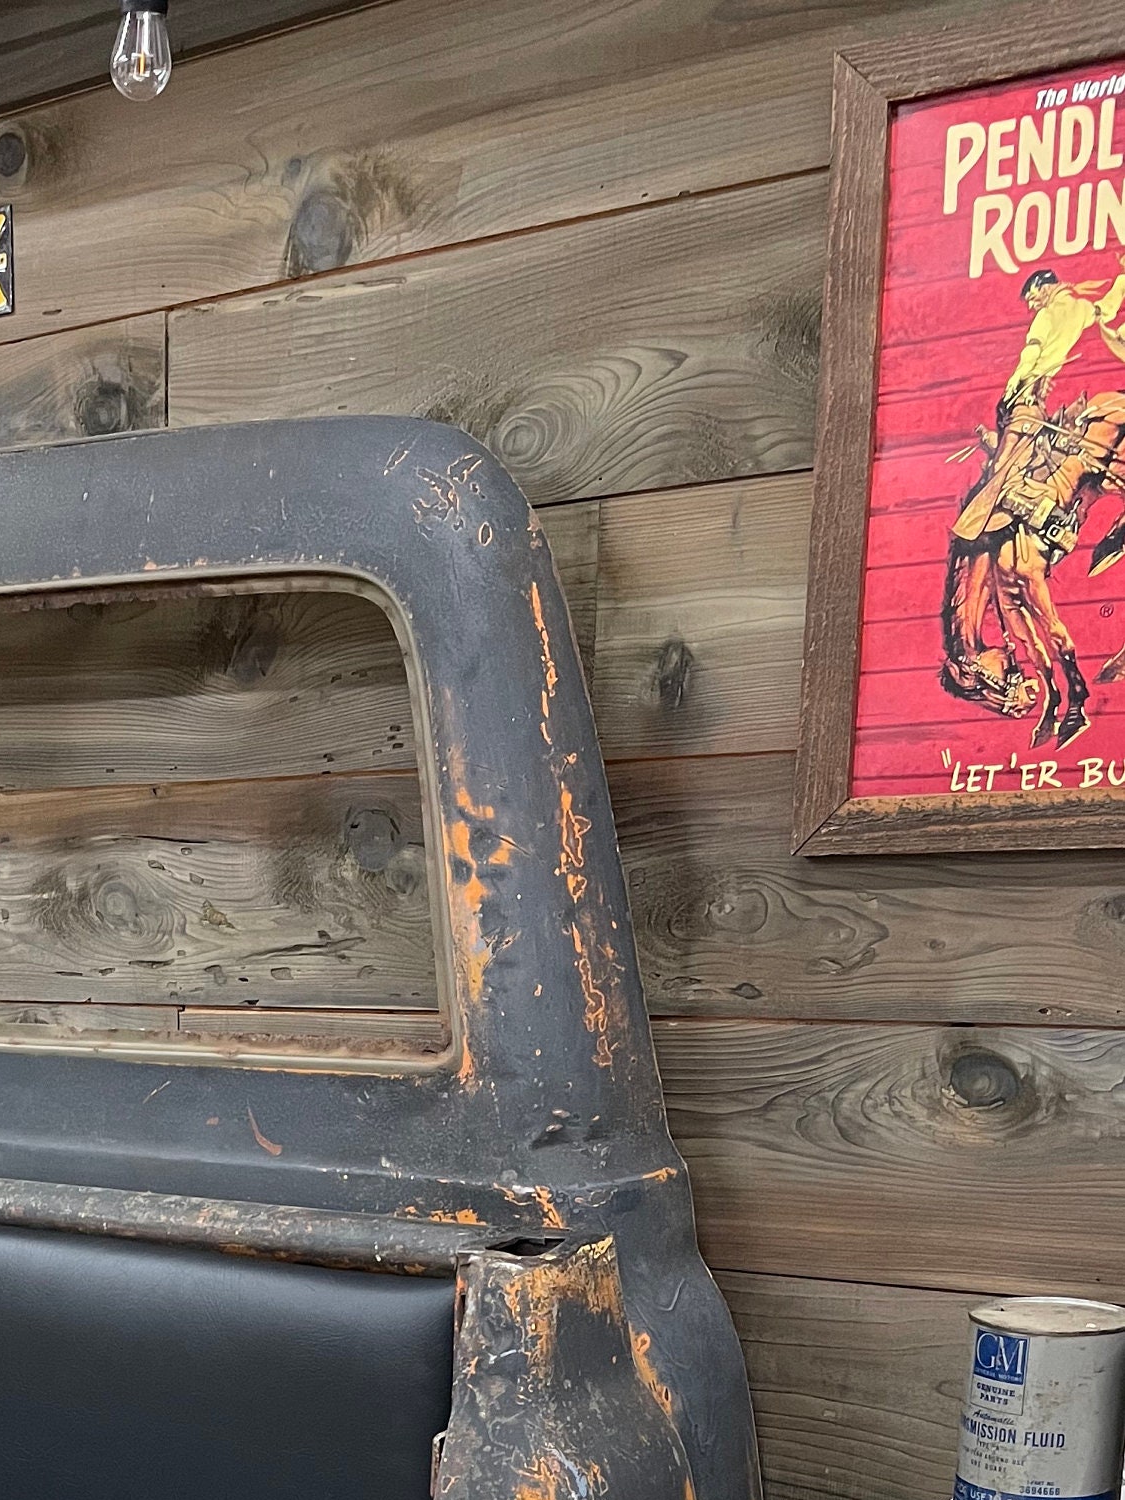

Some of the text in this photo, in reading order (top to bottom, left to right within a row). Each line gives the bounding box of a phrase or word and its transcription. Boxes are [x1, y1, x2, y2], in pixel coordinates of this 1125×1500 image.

[1036, 88, 1068, 110] The
[943, 97, 1124, 216] PENDL
[969, 179, 1125, 279] ROUN
[977, 1332, 1025, 1375] GM
[976, 1382, 1016, 1397] GENUINE
[980, 1392, 1008, 1406] PARTS
[1024, 1431, 1066, 1448] FLUID
